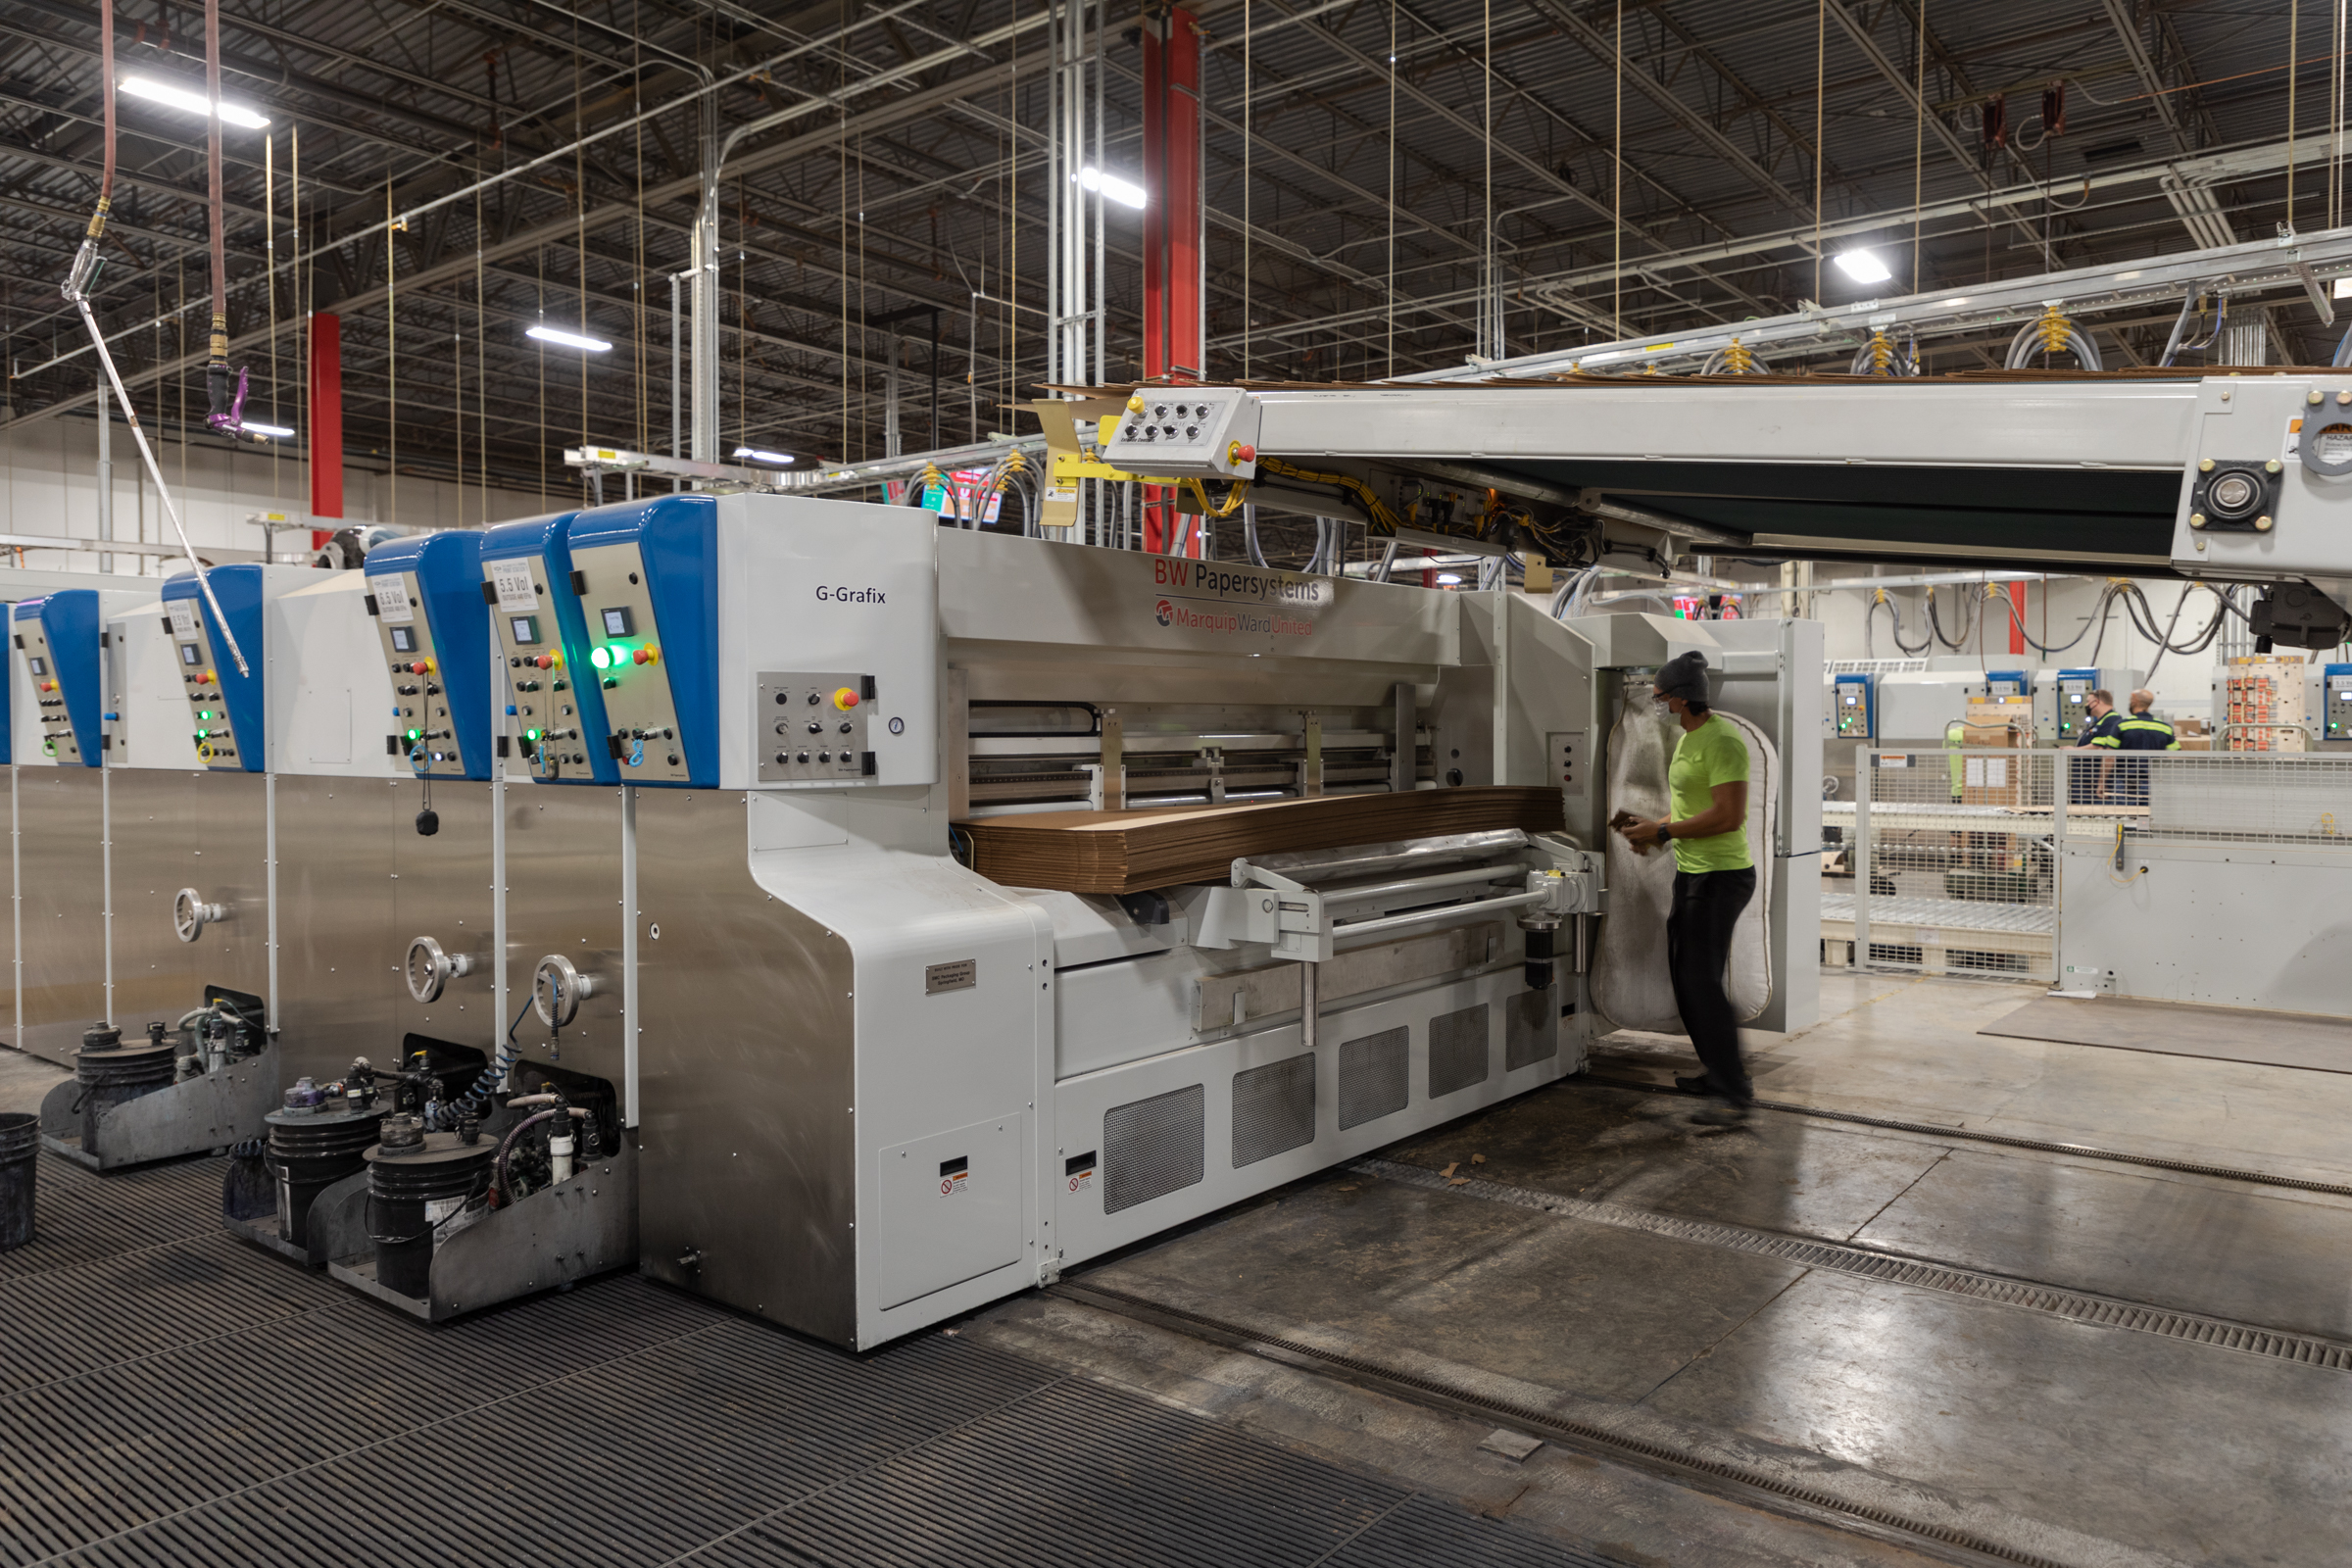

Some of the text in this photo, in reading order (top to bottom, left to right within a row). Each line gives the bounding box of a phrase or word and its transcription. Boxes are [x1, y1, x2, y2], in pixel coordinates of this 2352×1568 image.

[499, 576, 529, 593] 5.5 Vol
[1154, 558, 1319, 601] BW Papersystems
[391, 590, 405, 604] Vol
[815, 585, 886, 604] G-Grafix
[1176, 608, 1313, 636] MarquipWardUnited
